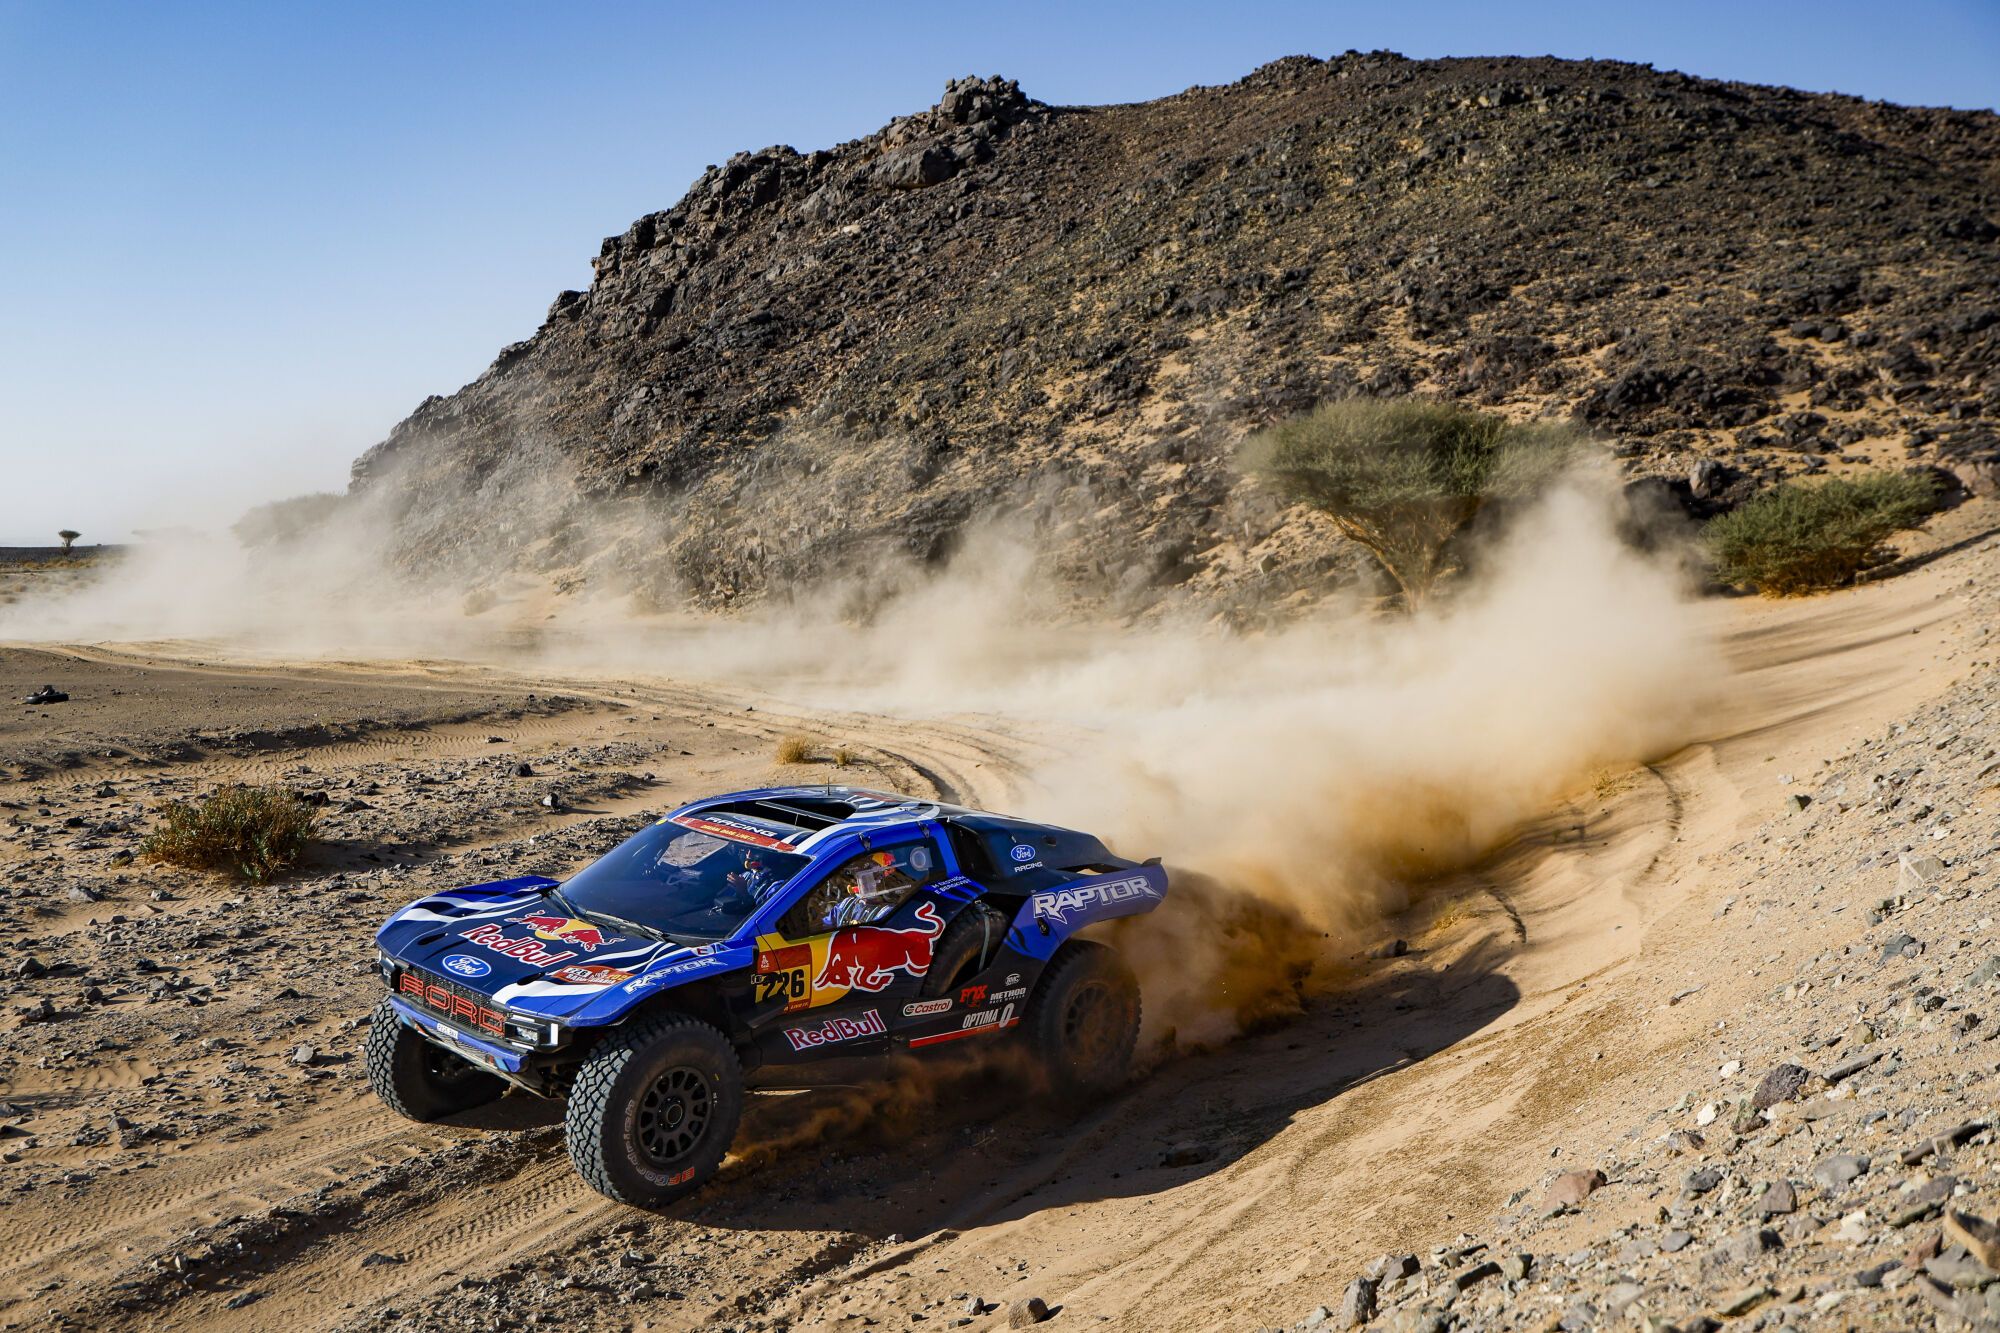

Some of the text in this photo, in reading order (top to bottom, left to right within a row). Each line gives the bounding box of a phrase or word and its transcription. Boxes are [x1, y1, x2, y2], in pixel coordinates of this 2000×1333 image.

[705, 817, 778, 837] RACING
[1016, 847, 1032, 859] Ford
[1014, 862, 1043, 873] RACING
[1033, 876, 1163, 924] RAPTOR
[448, 957, 484, 975] Ford
[622, 957, 728, 994] RAPTOR
[761, 969, 805, 1000] 226
[960, 984, 988, 1003] FOX
[990, 987, 1026, 1002] METHOD
[400, 973, 505, 1036] FORD
[914, 1001, 950, 1014] Castrol
[962, 1008, 999, 1029] OPTIMA
